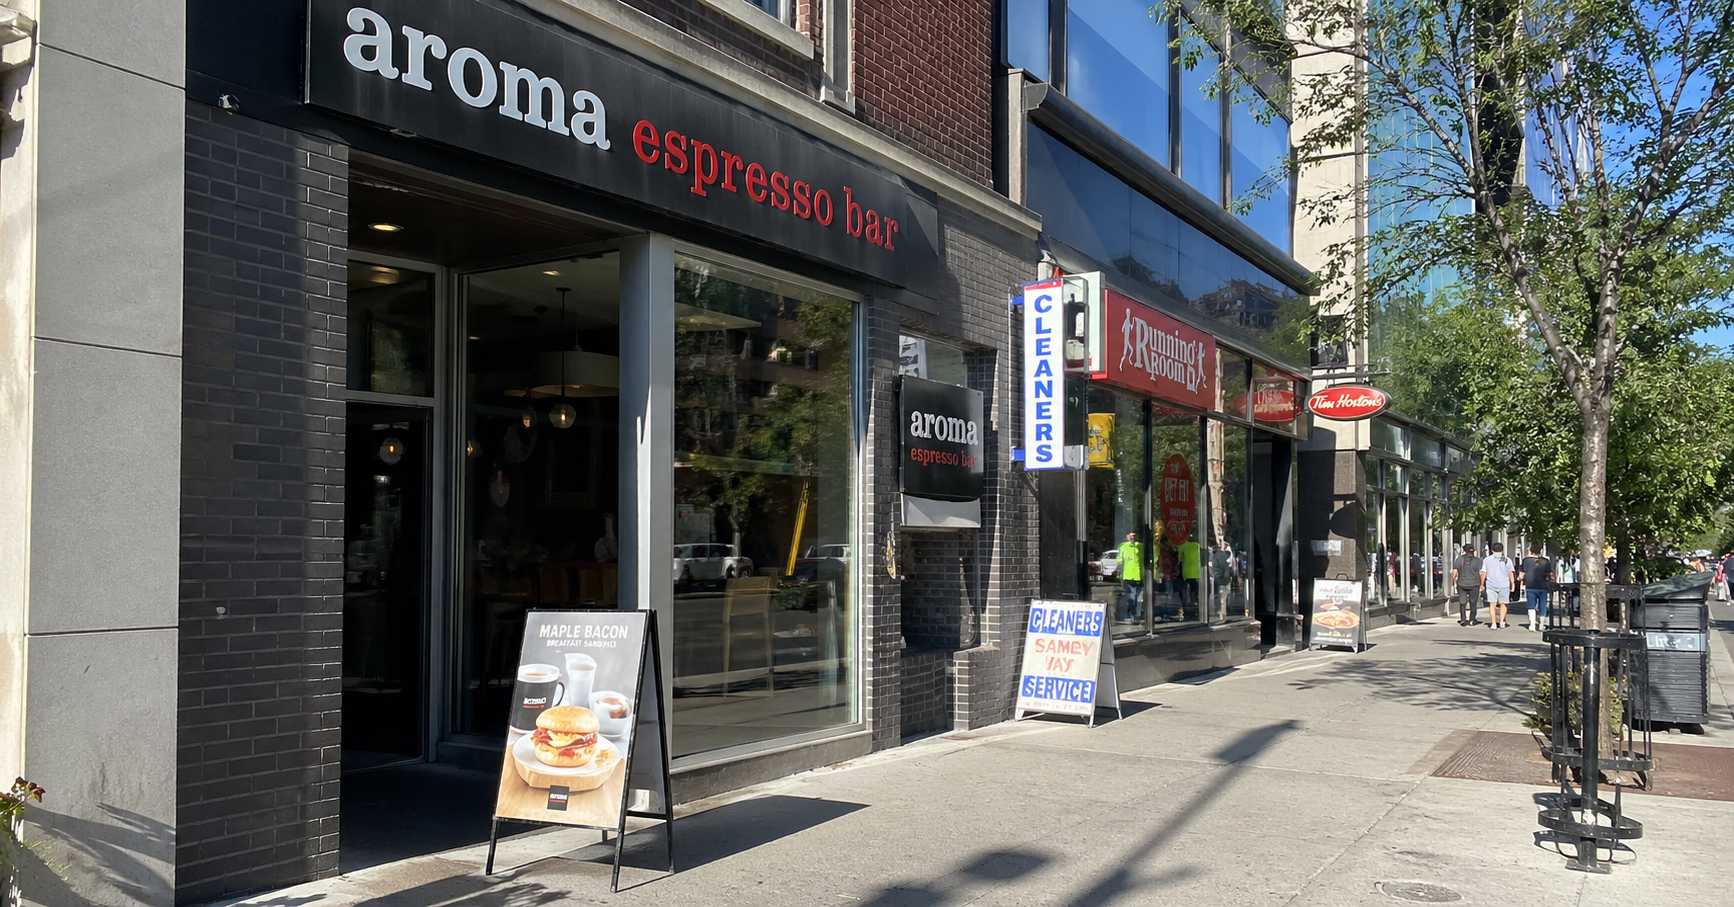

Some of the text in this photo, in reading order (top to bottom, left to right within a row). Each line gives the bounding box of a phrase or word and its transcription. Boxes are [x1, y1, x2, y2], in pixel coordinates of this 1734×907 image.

[343, 7, 900, 252] aroma espresso bar
[1134, 317, 1196, 391] Running
[1034, 294, 1053, 463] CLEANERS
[1313, 395, 1335, 409] Tim
[910, 411, 979, 446] aroma
[911, 447, 978, 468] espresso bar
[539, 624, 629, 639] MAPLE BACON
[1030, 608, 1102, 636] CLEANERS
[1022, 675, 1095, 703] SERVICE
